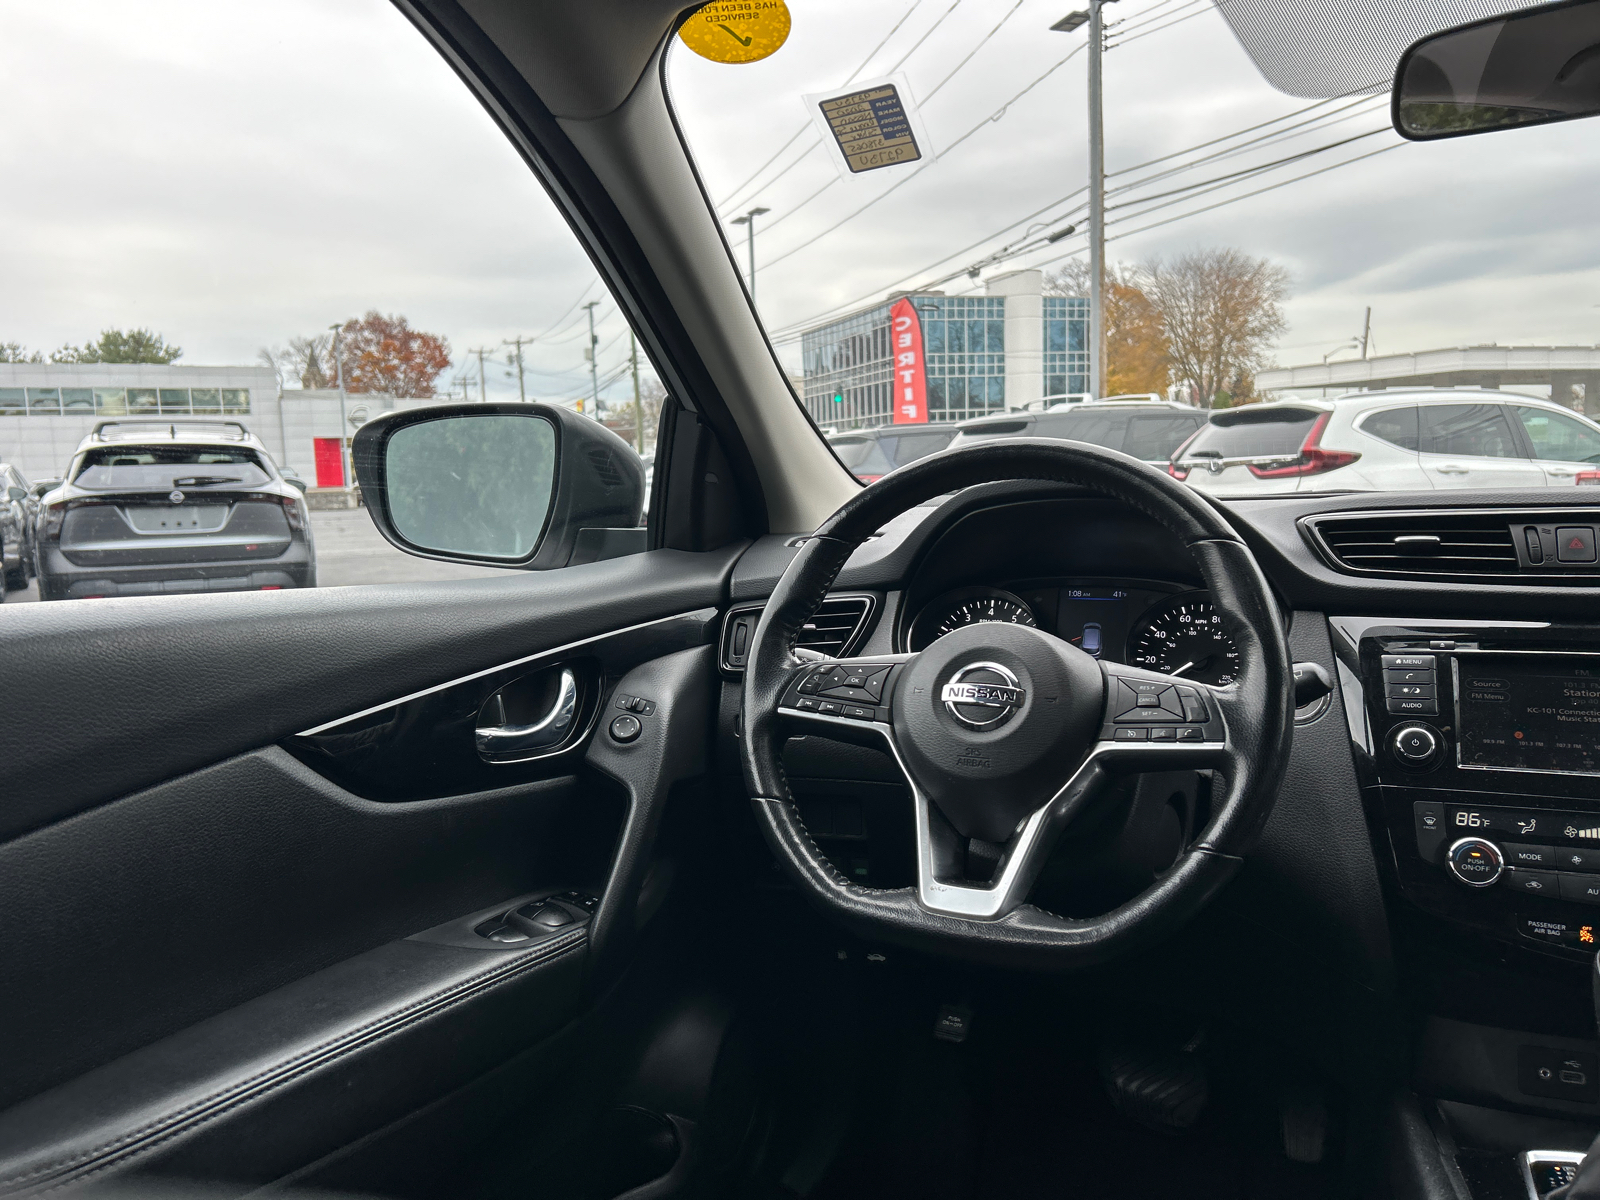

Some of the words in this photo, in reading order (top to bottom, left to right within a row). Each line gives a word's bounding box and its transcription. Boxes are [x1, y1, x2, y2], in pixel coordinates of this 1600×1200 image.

[965, 614, 971, 622] 3
[948, 688, 1016, 702] NISSAN
[966, 747, 982, 756] SRS
[956, 758, 991, 768] AIRBAG
[1518, 853, 1542, 861] MODE
[1528, 920, 1566, 930] PASSENGER
